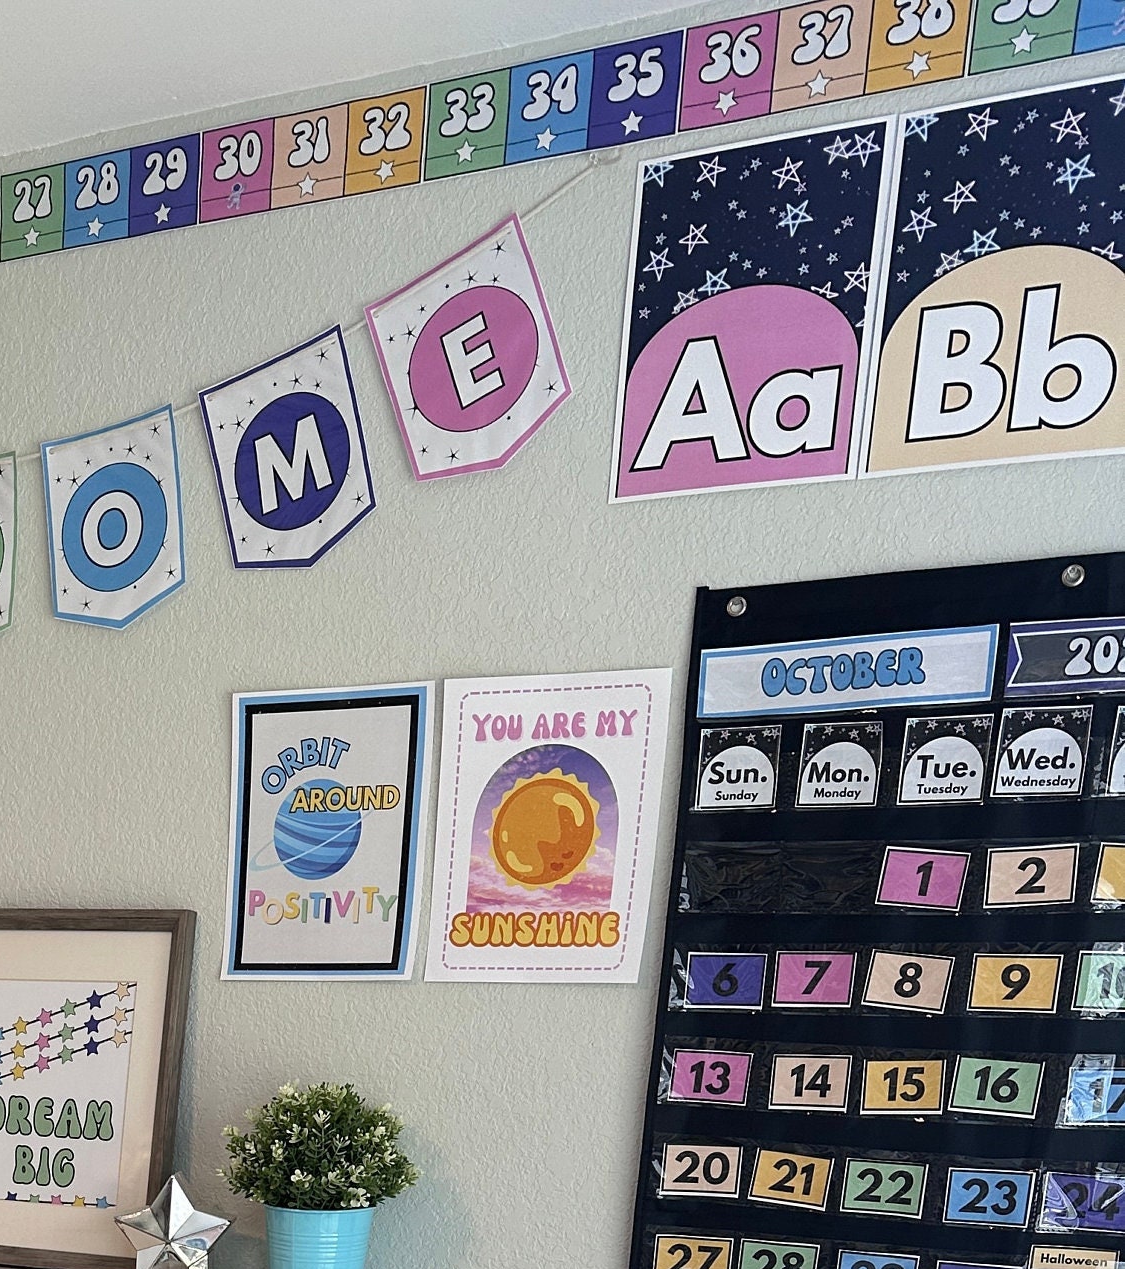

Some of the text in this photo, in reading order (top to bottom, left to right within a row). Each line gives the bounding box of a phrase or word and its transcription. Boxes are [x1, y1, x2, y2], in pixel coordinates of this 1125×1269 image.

[12, 175, 54, 223] 27
[74, 161, 120, 210] 28
[141, 147, 188, 196] 29
[213, 130, 263, 181] 30
[287, 116, 331, 168] 31
[358, 101, 412, 155] 32
[439, 81, 496, 137] 33
[521, 62, 578, 122] 34
[607, 47, 664, 102] 35
[699, 25, 761, 84] 36
[792, 4, 852, 65] 37
[886, 0, 955, 46] 38
[905, 283, 1118, 443] Bb
[629, 335, 844, 473] Aa
[761, 646, 926, 697] OCTOBER
[472, 708, 638, 741] YOU ARE MY
[261, 736, 351, 794] ORBIT
[708, 761, 768, 785] Sun.
[806, 762, 870, 784] Mon.
[916, 754, 977, 779] Tue.
[1006, 746, 1076, 771] Wed.
[290, 785, 401, 813] AROUND
[715, 789, 758, 803] Sunday
[813, 787, 861, 801] Monday
[916, 781, 968, 796] Tuesday
[1001, 773, 1077, 789] Wednesday
[915, 856, 1047, 897] 1 2
[248, 886, 397, 925] POSITIVITY
[712, 963, 739, 997] 6
[801, 960, 832, 995] 7
[894, 962, 924, 998] 8
[1000, 964, 1031, 1000] 9
[689, 1060, 731, 1096] 13
[790, 1064, 832, 1098] 14
[882, 1067, 925, 1102] 15
[974, 1065, 1019, 1103] 16
[12, 1144, 75, 1188] BIG
[672, 1151, 730, 1185] 20
[768, 1159, 816, 1196] 21
[853, 1167, 914, 1205] 22
[957, 1178, 1018, 1216] 23
[1040, 1252, 1108, 1268] Halloween
